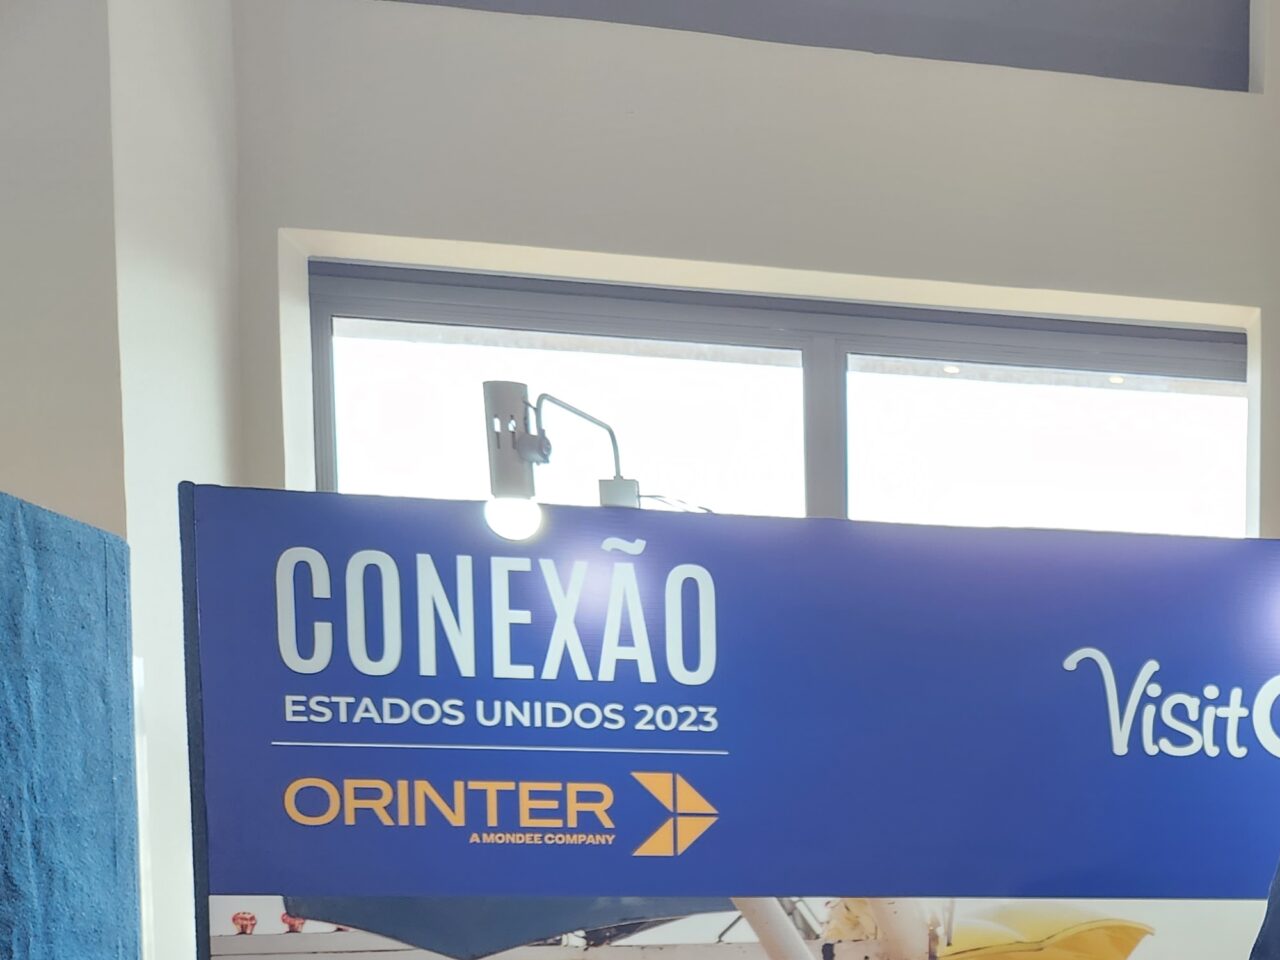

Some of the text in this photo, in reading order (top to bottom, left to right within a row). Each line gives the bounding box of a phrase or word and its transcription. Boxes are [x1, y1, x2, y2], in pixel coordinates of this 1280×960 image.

[275, 536, 717, 686] CONEXÃO
[284, 695, 719, 732] ESTADOS UNIDOS 2023
[283, 777, 615, 829] ORINTER
[469, 832, 616, 846] A MONDEE COMPANY
